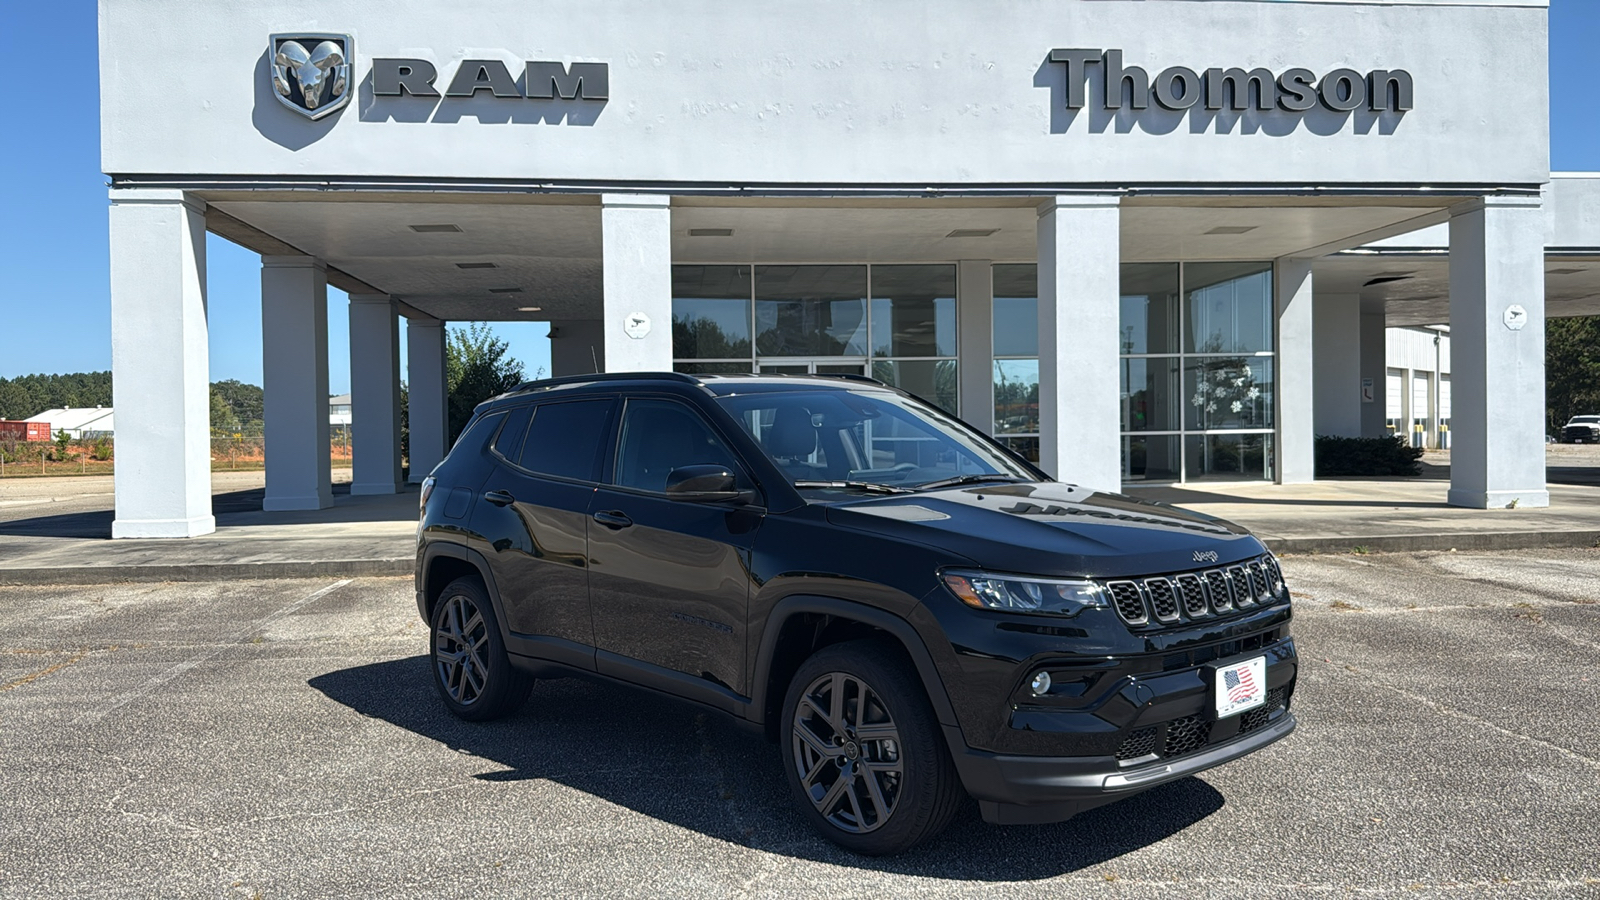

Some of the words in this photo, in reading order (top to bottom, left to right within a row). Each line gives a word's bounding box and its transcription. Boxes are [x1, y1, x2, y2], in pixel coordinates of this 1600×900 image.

[371, 58, 609, 100] RAM
[1048, 48, 1413, 111] Thomson
[1192, 550, 1219, 563] Jeep
